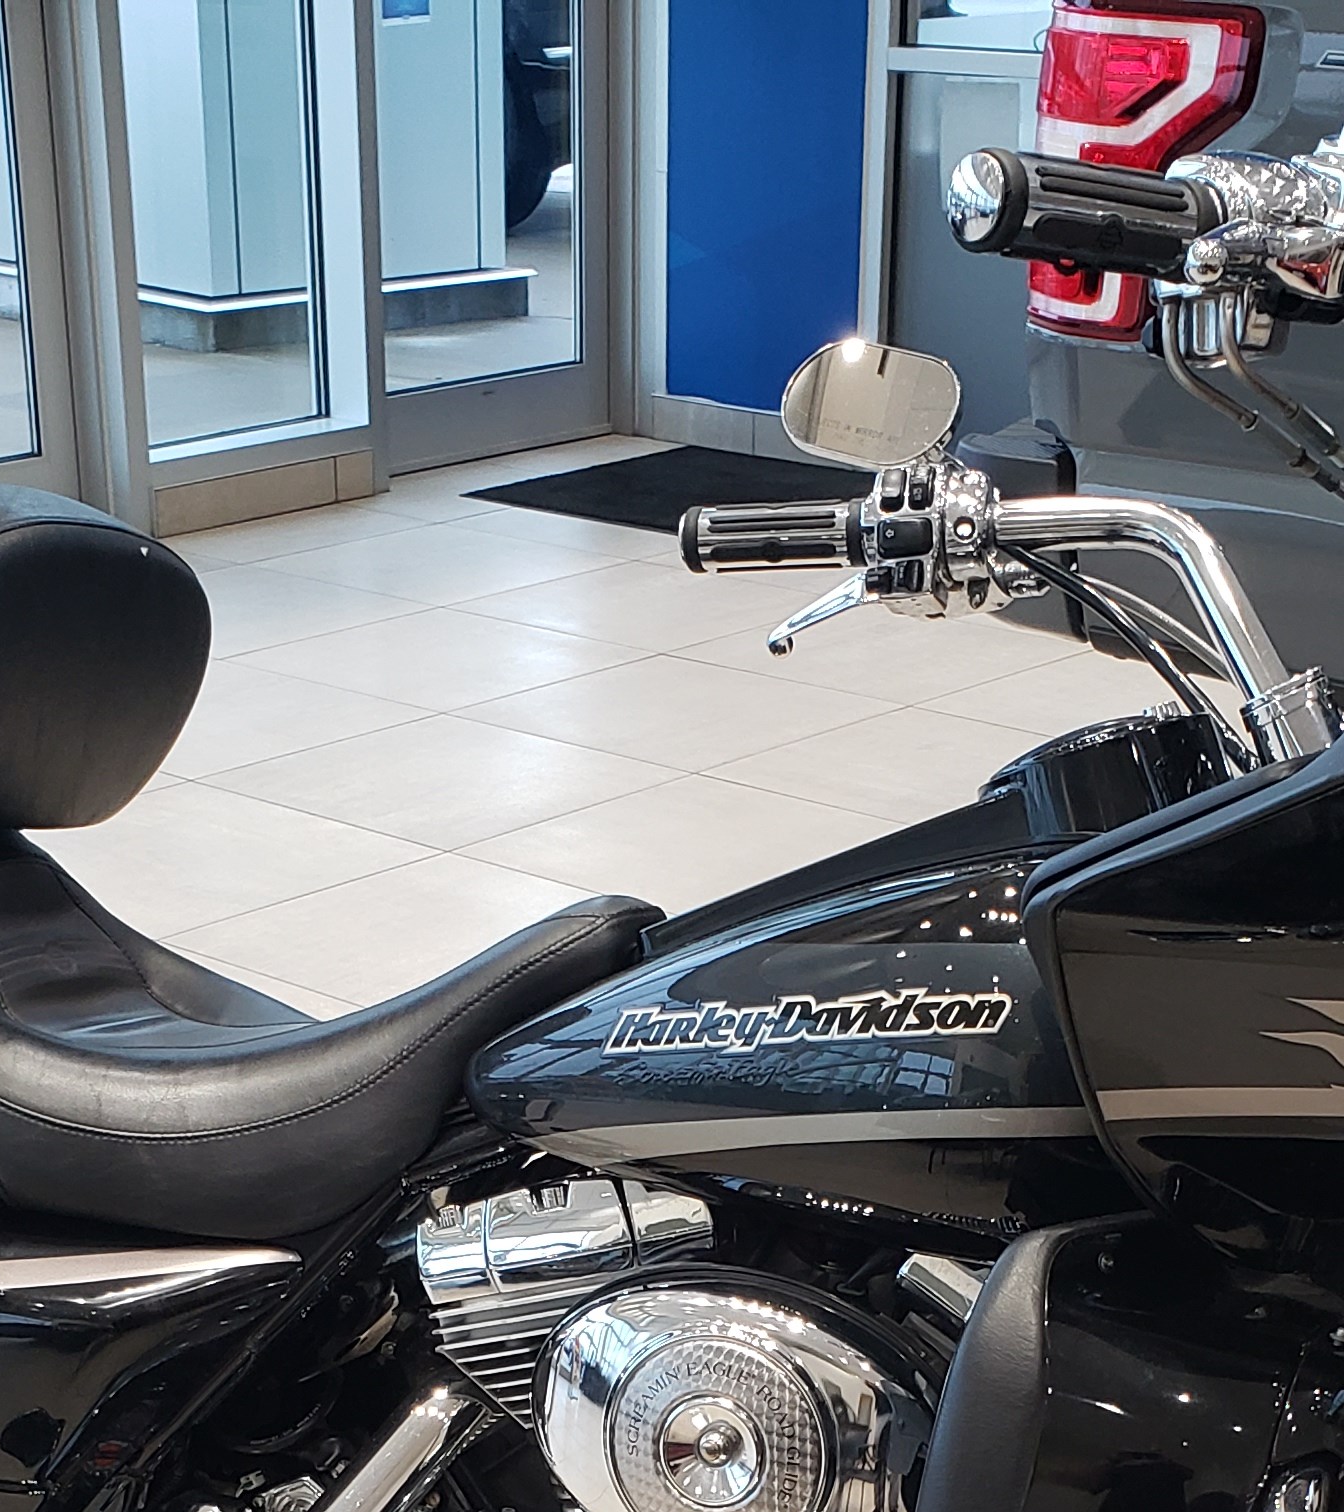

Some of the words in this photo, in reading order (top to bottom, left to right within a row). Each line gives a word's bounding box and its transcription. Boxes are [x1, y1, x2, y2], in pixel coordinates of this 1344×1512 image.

[604, 987, 1014, 1056] Harley-Davidson
[685, 1361, 751, 1386] EAGLE
[756, 1385, 795, 1438] ROAD
[777, 1446, 801, 1504] GLIDE
